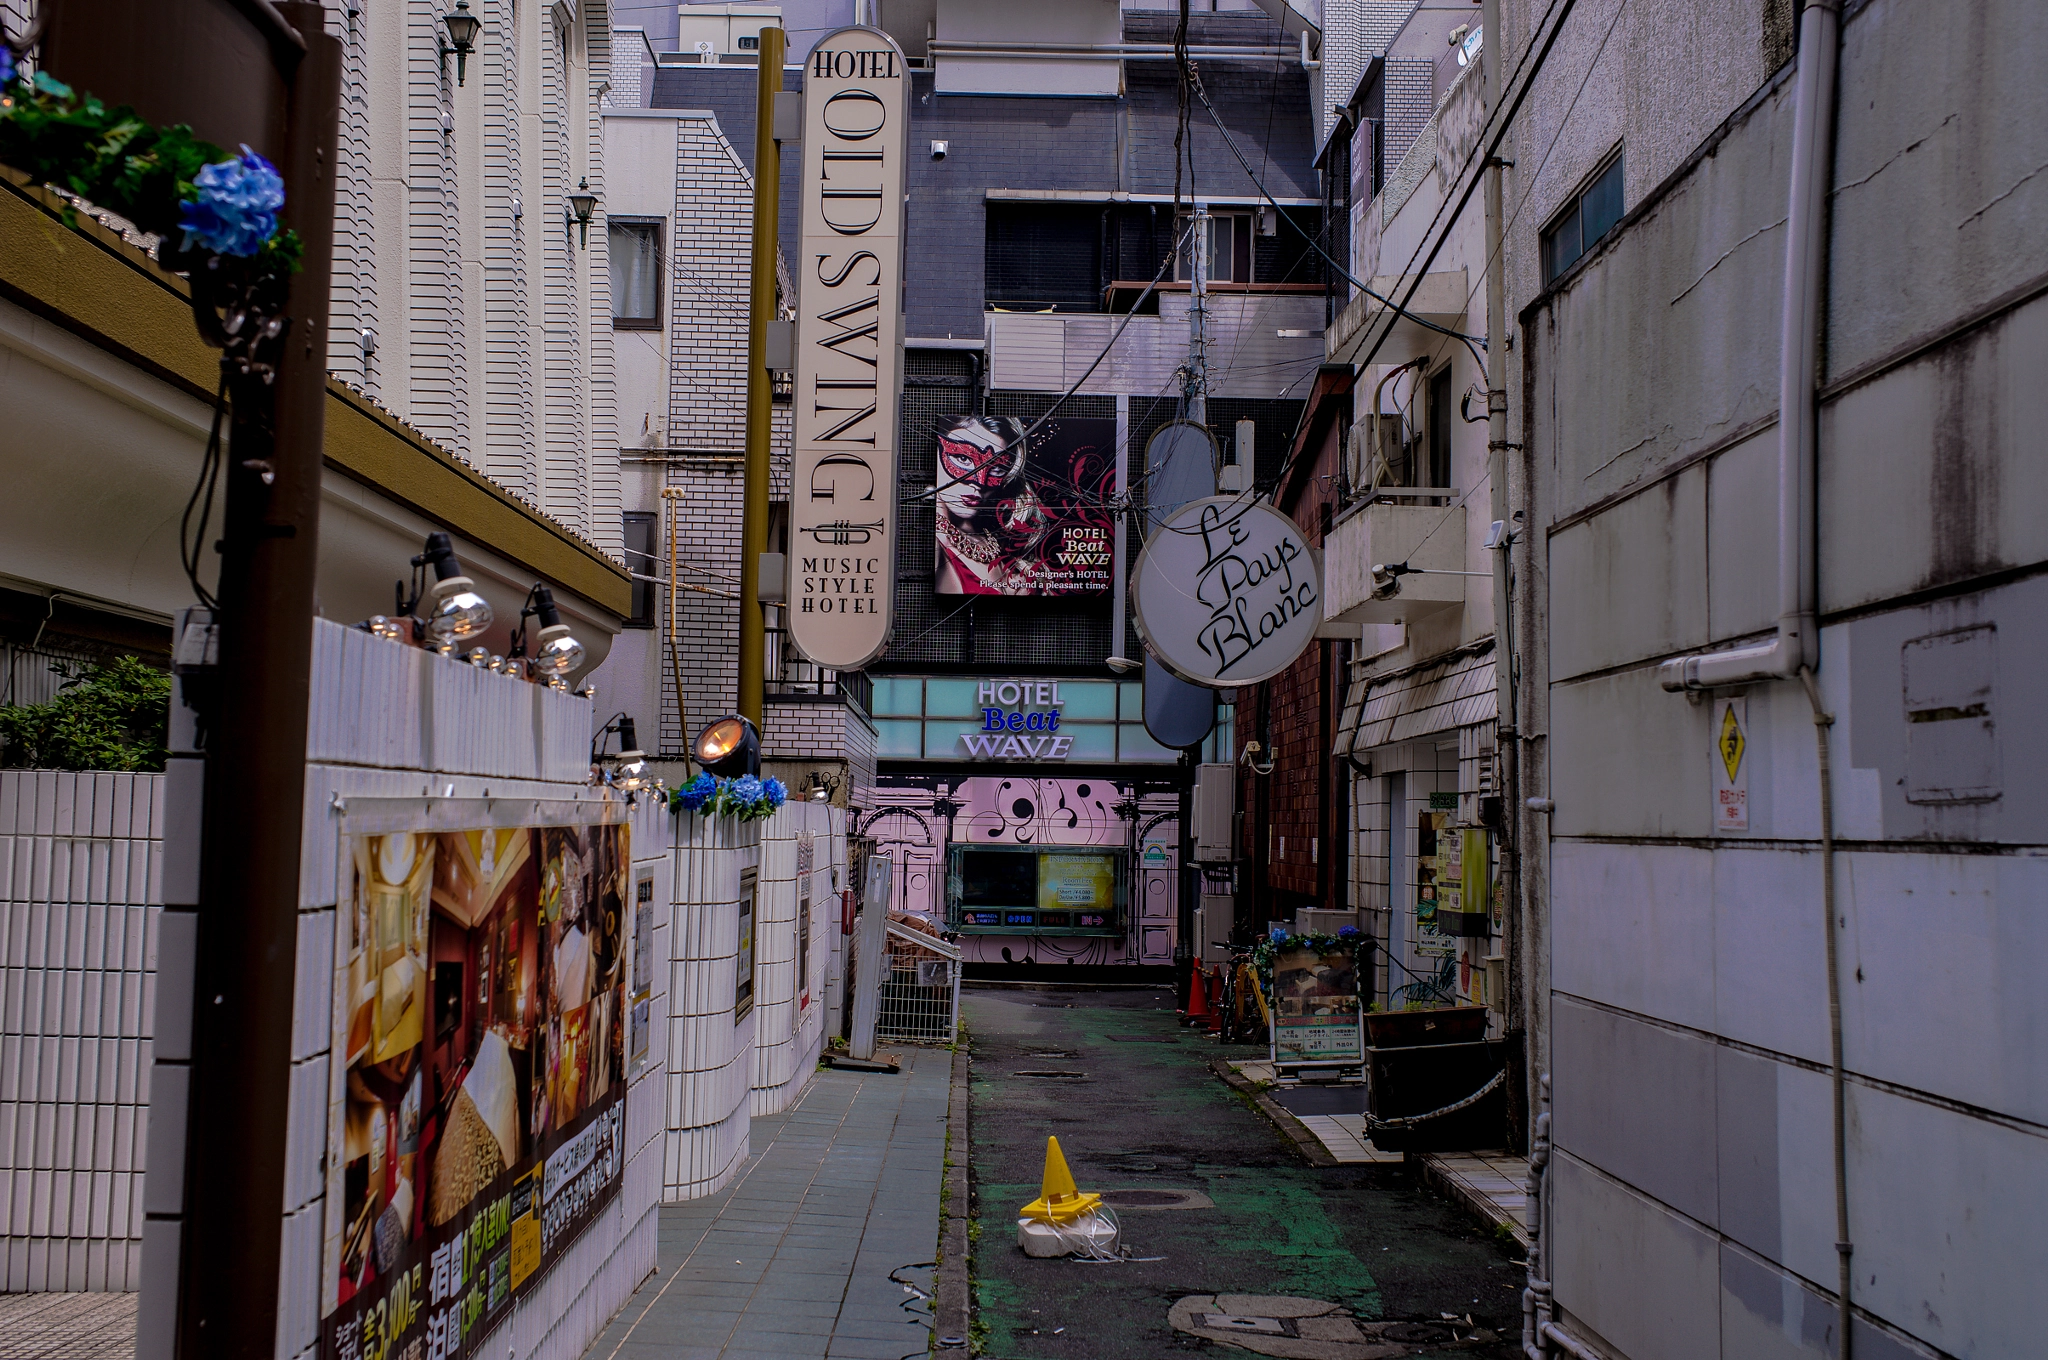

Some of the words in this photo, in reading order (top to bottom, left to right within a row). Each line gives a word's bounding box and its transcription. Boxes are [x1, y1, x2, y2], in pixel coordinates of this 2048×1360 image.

[813, 50, 900, 79] HOTEL
[820, 89, 886, 236] OLD
[810, 250, 881, 504] SWING
[1063, 528, 1108, 539] HOTEL
[1065, 540, 1105, 552] Beat
[802, 557, 879, 574] MUSIC
[1055, 552, 1111, 565] WAVE
[1076, 570, 1109, 579] HOTEL
[1197, 537, 1302, 619] Pays
[804, 577, 875, 594] STYLE
[979, 579, 1007, 588] Please
[1009, 579, 1037, 590] spend
[1046, 580, 1083, 591] pleasant
[1085, 581, 1109, 590] time.
[801, 598, 878, 615] HOTEL
[1197, 582, 1317, 679] Blanc
[978, 682, 1065, 706] HOTEL
[981, 707, 1061, 733] Beat
[960, 734, 1075, 759] WAVE
[1007, 915, 1033, 923] OPEN
[1043, 915, 1065, 924] FULL
[1081, 915, 1093, 926] IN
